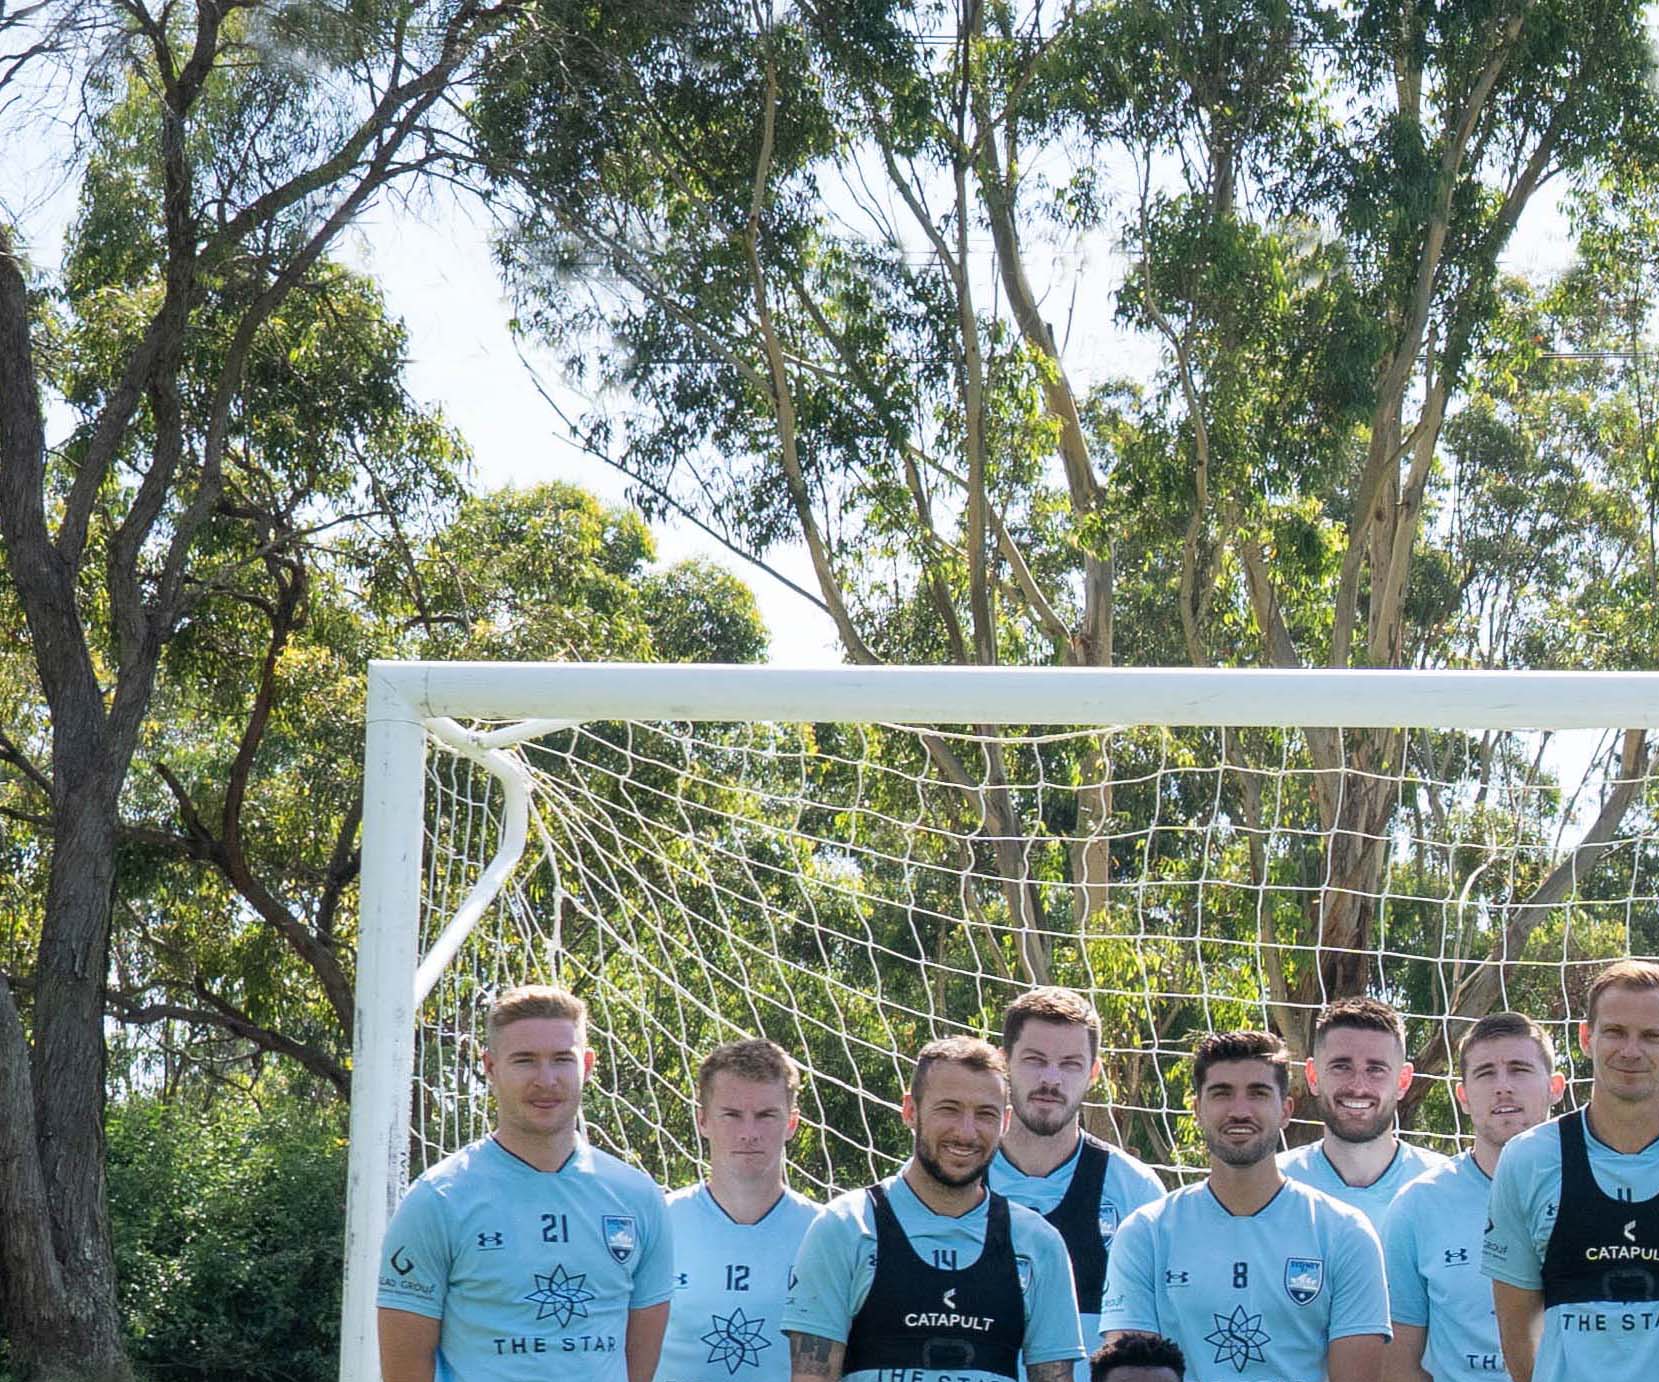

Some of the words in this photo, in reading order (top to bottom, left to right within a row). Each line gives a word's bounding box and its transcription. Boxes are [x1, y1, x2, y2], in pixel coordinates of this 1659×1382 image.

[541, 1213, 569, 1244] 21
[931, 1248, 957, 1271] 14
[725, 1263, 751, 1291] 12
[1232, 1261, 1249, 1289] 8
[905, 1312, 995, 1332] CATAPULT
[1562, 1313, 1607, 1331] THE
[493, 1337, 547, 1356] THE
[562, 1335, 617, 1353] STAR
[1467, 1354, 1498, 1371] TH
